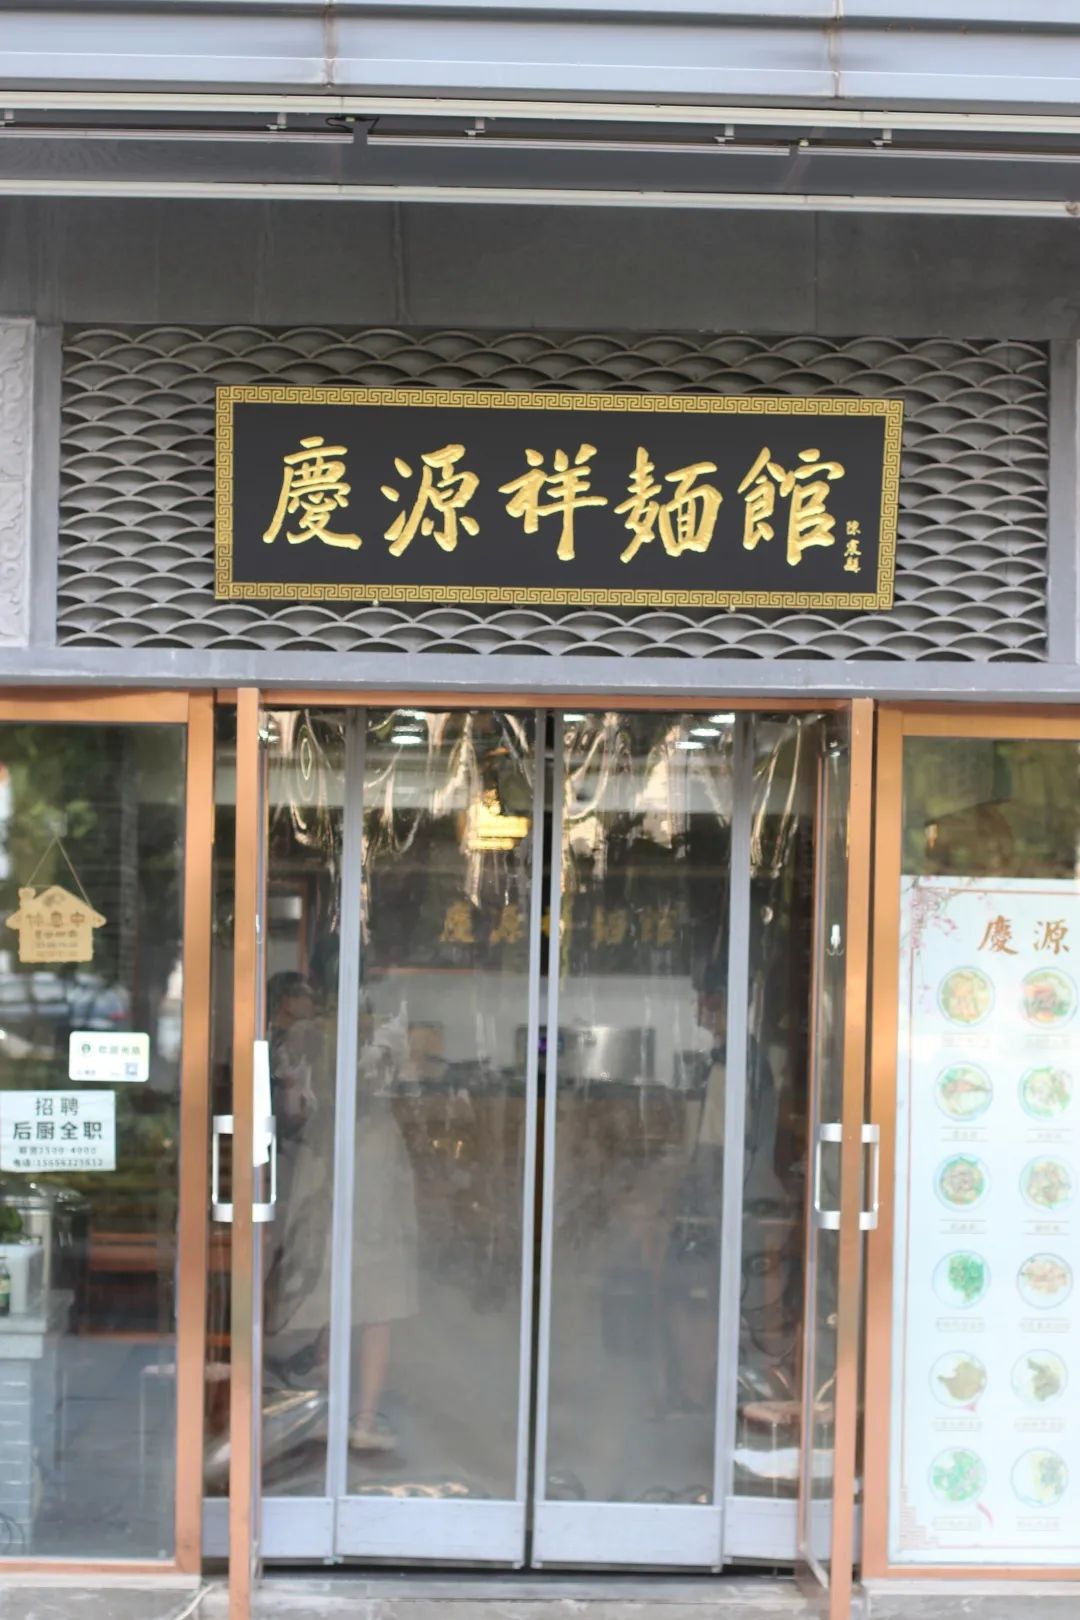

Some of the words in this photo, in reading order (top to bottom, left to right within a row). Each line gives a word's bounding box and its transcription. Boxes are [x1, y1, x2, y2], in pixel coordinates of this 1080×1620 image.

[977, 914, 1070, 955] 慶源
[35, 1097, 79, 1116] 招聘
[12, 1121, 103, 1140] 后厨全职
